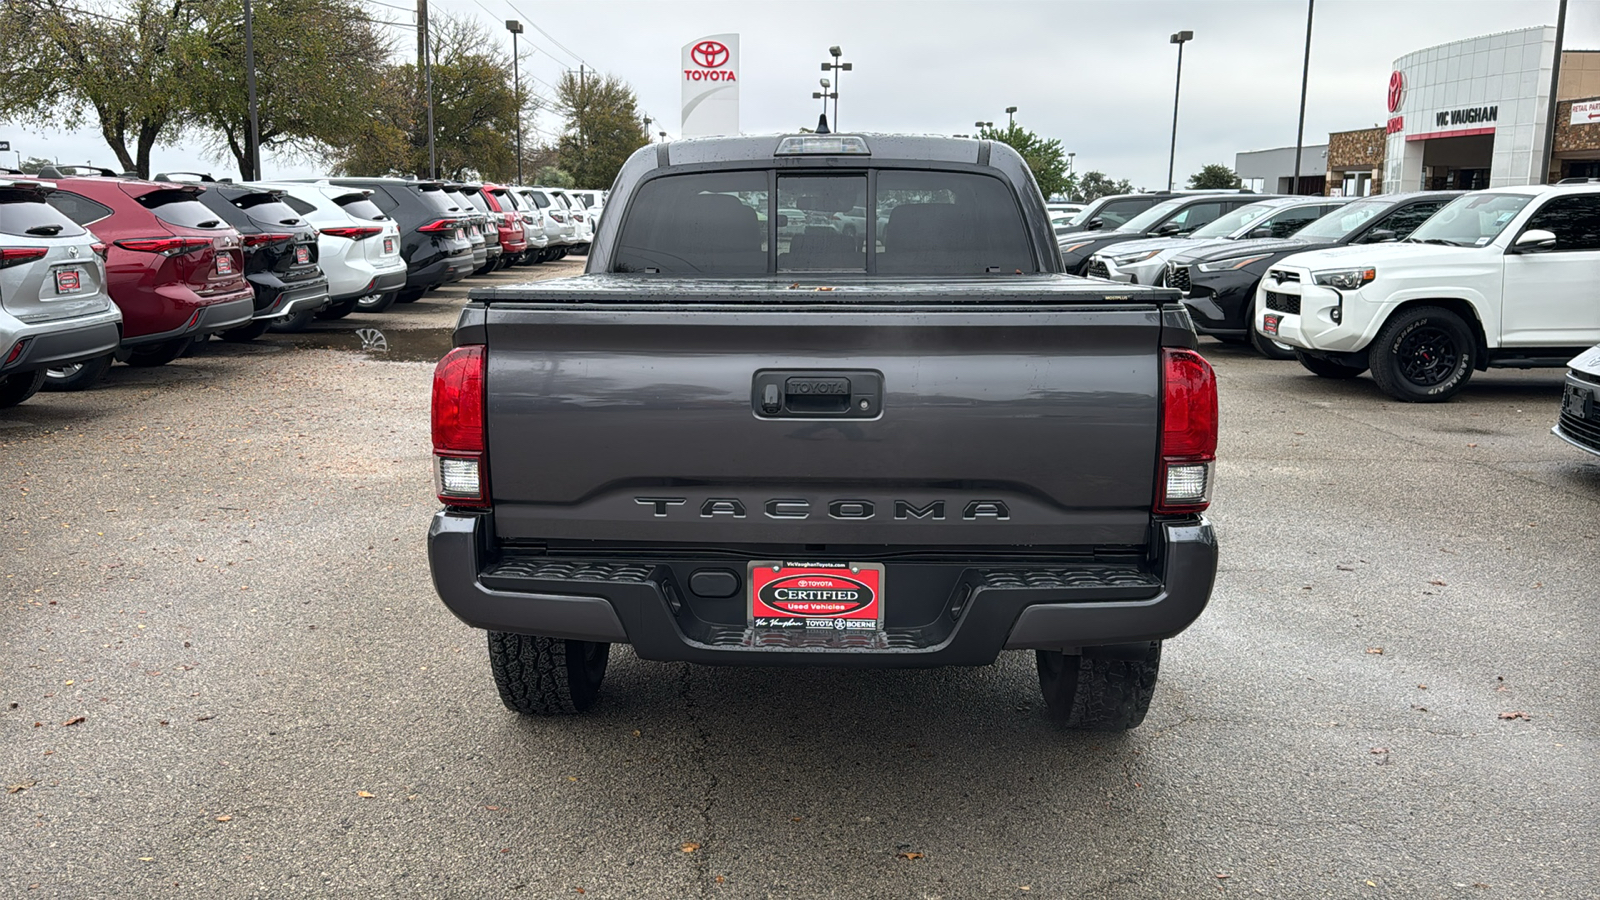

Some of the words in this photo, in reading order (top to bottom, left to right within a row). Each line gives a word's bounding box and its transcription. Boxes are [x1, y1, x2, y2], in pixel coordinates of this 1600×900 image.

[684, 70, 736, 81] TOYOTA
[1436, 111, 1449, 127] VIC
[1451, 105, 1498, 125] VAUGHAN
[1392, 318, 1428, 354] IRONMAN
[1445, 353, 1469, 388] RADIAL
[791, 382, 846, 394] TOYOTA
[634, 497, 1011, 520] TACOMA
[806, 620, 834, 628] TOYOTA
